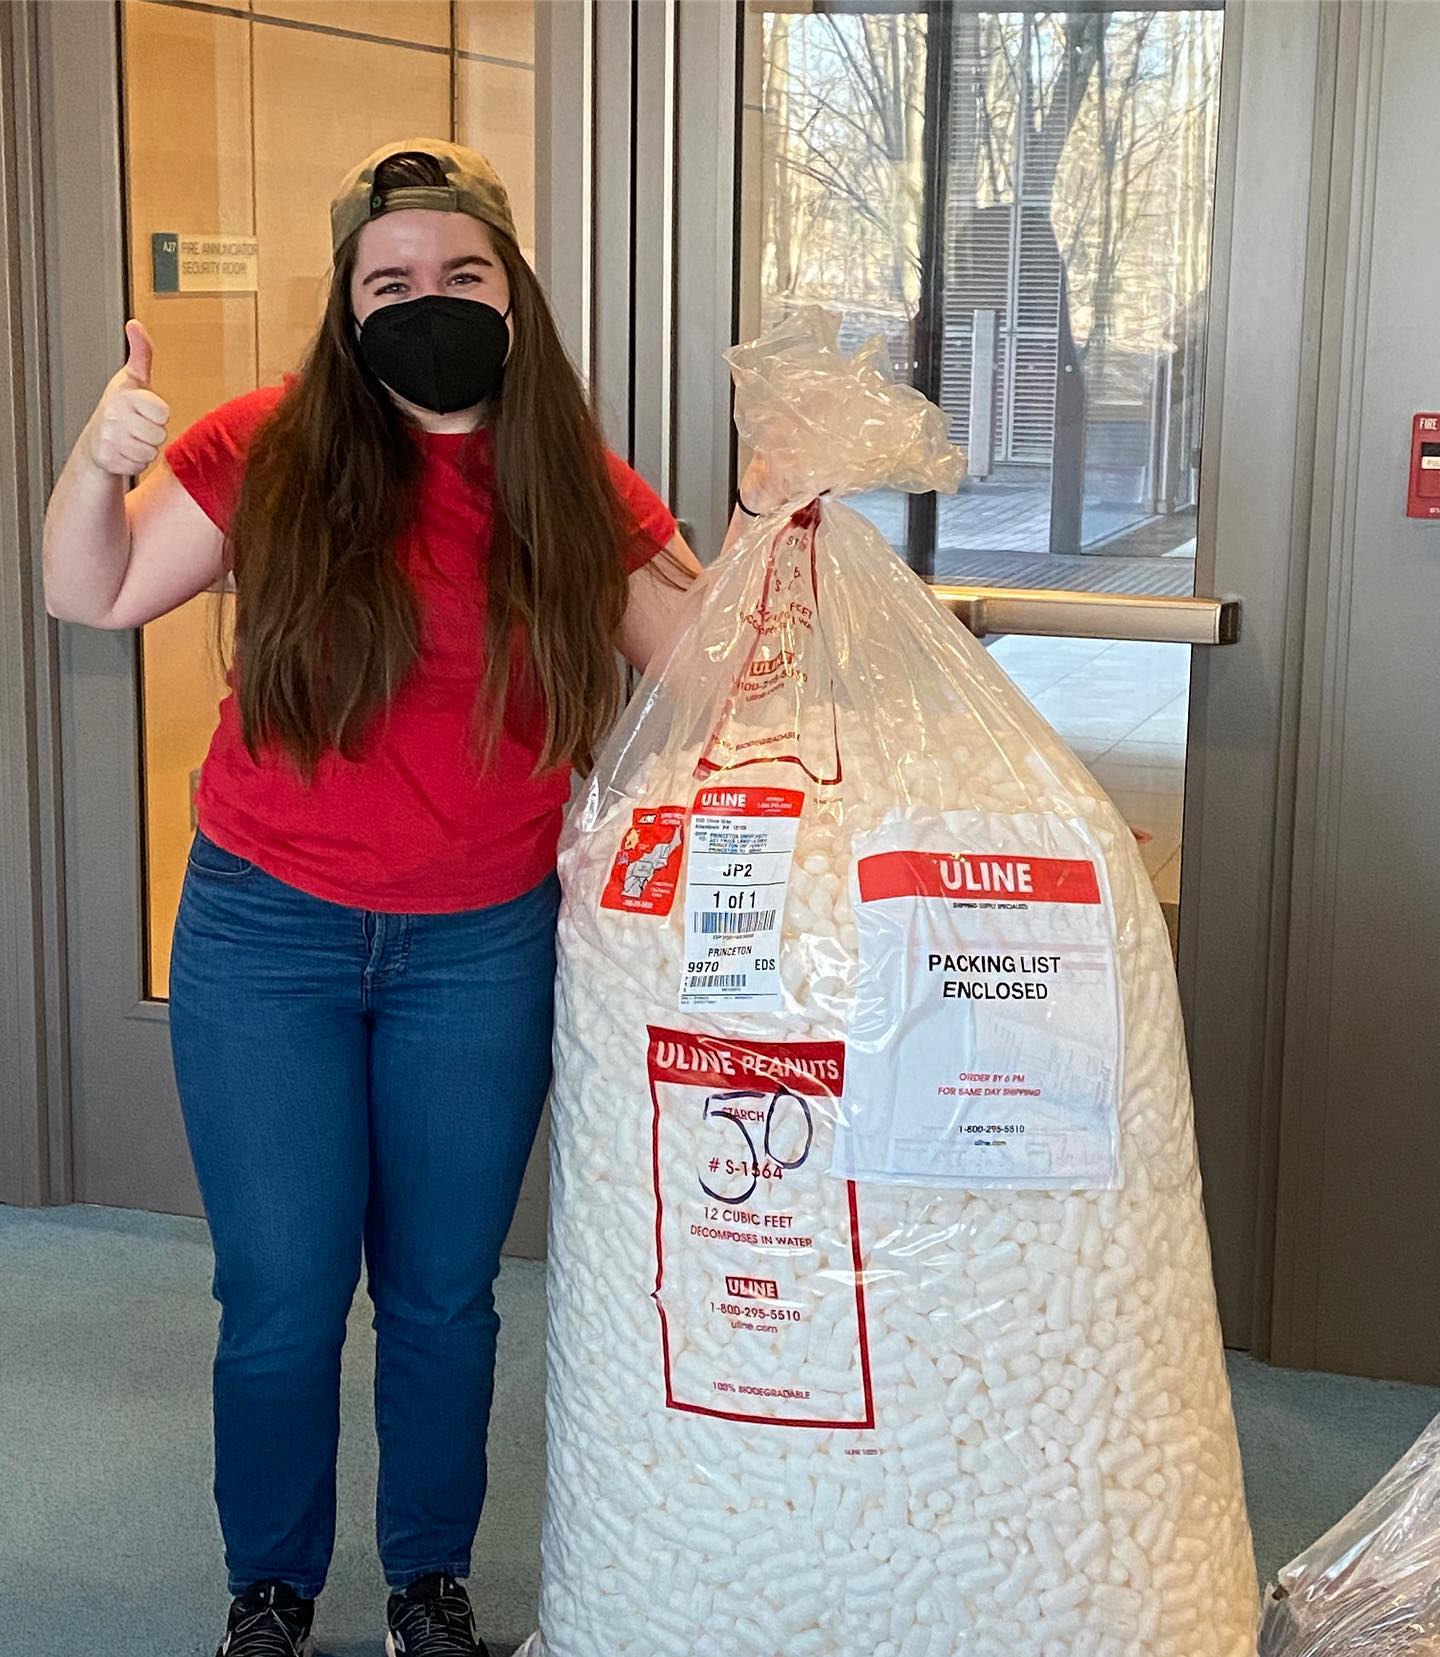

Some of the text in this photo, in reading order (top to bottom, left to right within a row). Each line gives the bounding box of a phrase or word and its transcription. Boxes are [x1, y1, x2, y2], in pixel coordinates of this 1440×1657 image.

[163, 241, 177, 253] A27
[181, 241, 200, 256] FIRE
[182, 261, 247, 275] SECURITY ROOM
[1419, 417, 1438, 431] FIRE
[701, 792, 747, 808] ULINE
[723, 864, 753, 877] JP2
[939, 859, 1034, 893] ULINE
[713, 891, 756, 909] 1 of 1
[708, 946, 753, 957] PRINCETON
[687, 959, 776, 973] 9970 EDS
[928, 954, 1061, 974] PACKING LIST
[943, 981, 1048, 1000] ENCLOSED
[656, 1040, 839, 1080] ULINE PEANUTS
[959, 1072, 1025, 1083] ORDER BY 6 PM
[938, 1087, 1041, 1097] FOR SAME DAY SHIPPING
[722, 1107, 765, 1122] STARCH
[959, 1125, 1025, 1134] 1-800-295-5510
[697, 1086, 813, 1205] 50
[708, 1157, 720, 1172] #
[704, 1206, 793, 1228] 12 CUBIC FEET
[690, 1224, 813, 1247] DECOMPOSES IN WATER
[727, 1279, 776, 1297] ULINE
[710, 1302, 801, 1322] 1-800-295-5510
[731, 1321, 778, 1333] uline.com
[713, 1381, 811, 1400] 100% BIODEGRADABLE
